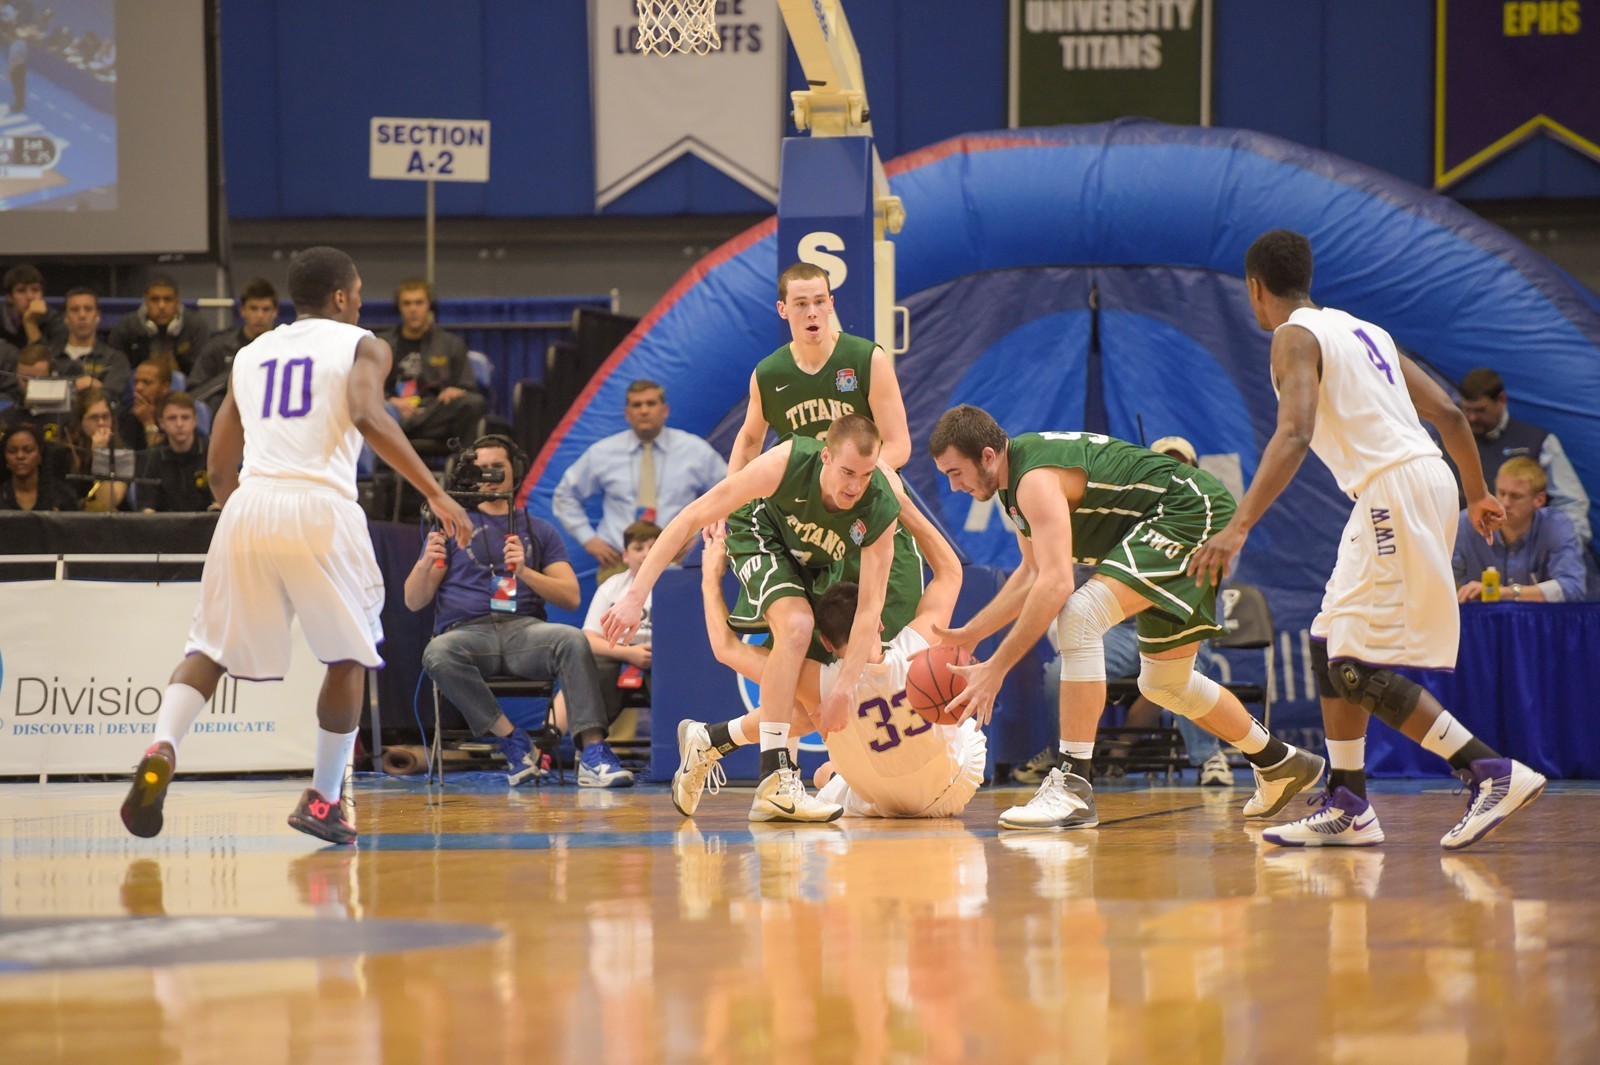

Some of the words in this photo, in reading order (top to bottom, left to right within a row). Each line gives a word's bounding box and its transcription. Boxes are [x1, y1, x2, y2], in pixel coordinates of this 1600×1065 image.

[1025, 0, 1196, 33] UNIVERSITY
[1503, 1, 1580, 36] EPHS
[1059, 34, 1162, 69] TITANS
[378, 125, 484, 146] SECTION
[1353, 328, 1395, 385] 4
[259, 356, 314, 418] 10
[785, 398, 855, 431] TITANS
[785, 514, 846, 561] TITANS
[1139, 528, 1184, 560] IWU
[15, 676, 162, 716] Divisio
[13, 722, 95, 736] DISCOVER
[194, 720, 276, 734] DEDICATE
